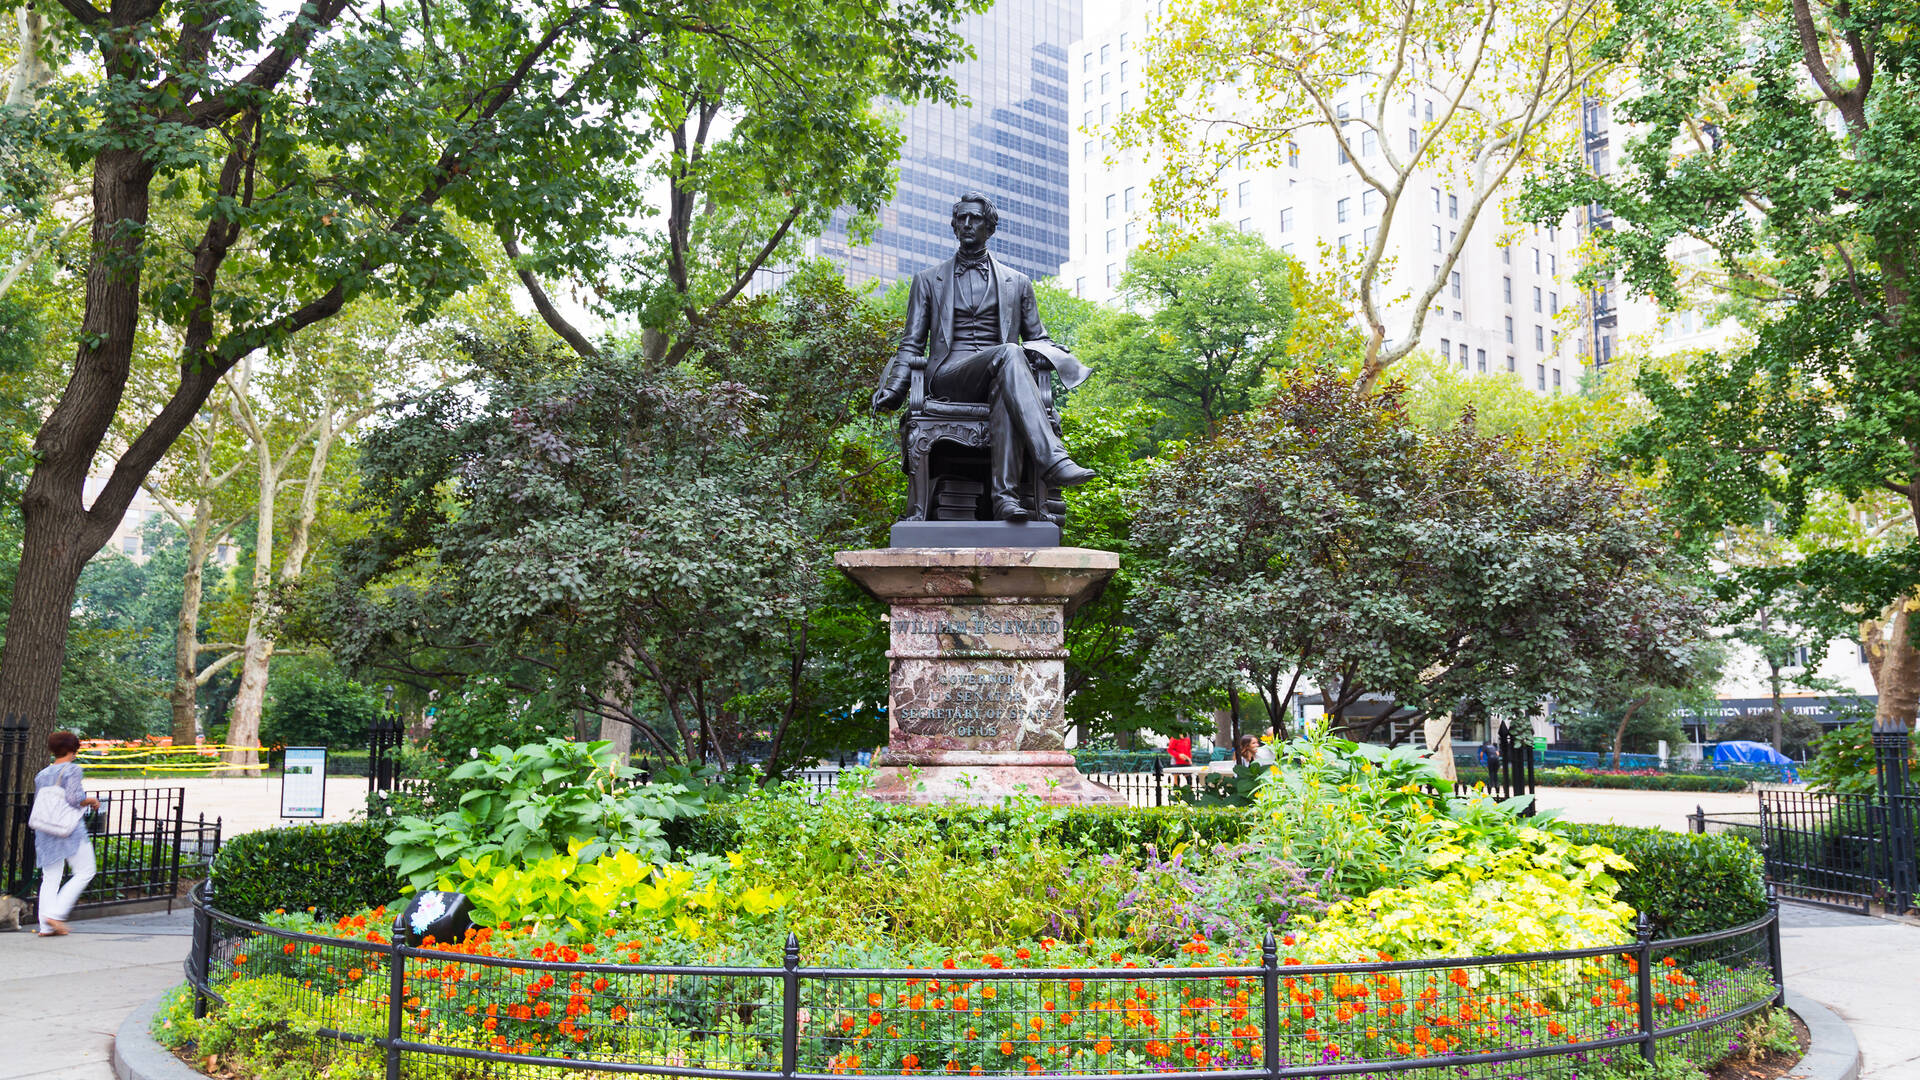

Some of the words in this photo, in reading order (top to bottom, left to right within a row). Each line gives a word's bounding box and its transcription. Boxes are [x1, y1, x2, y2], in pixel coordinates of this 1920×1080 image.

[895, 620, 968, 634] WILLIAM
[974, 620, 985, 634] H
[991, 620, 1060, 635] SEWARD
[938, 674, 1015, 686] GOVERNOR
[957, 692, 1022, 702] SENATOR
[901, 709, 980, 719] SECRETARY
[986, 709, 1000, 719] OF
[1009, 709, 1053, 719] STATE
[957, 726, 973, 737] OF
